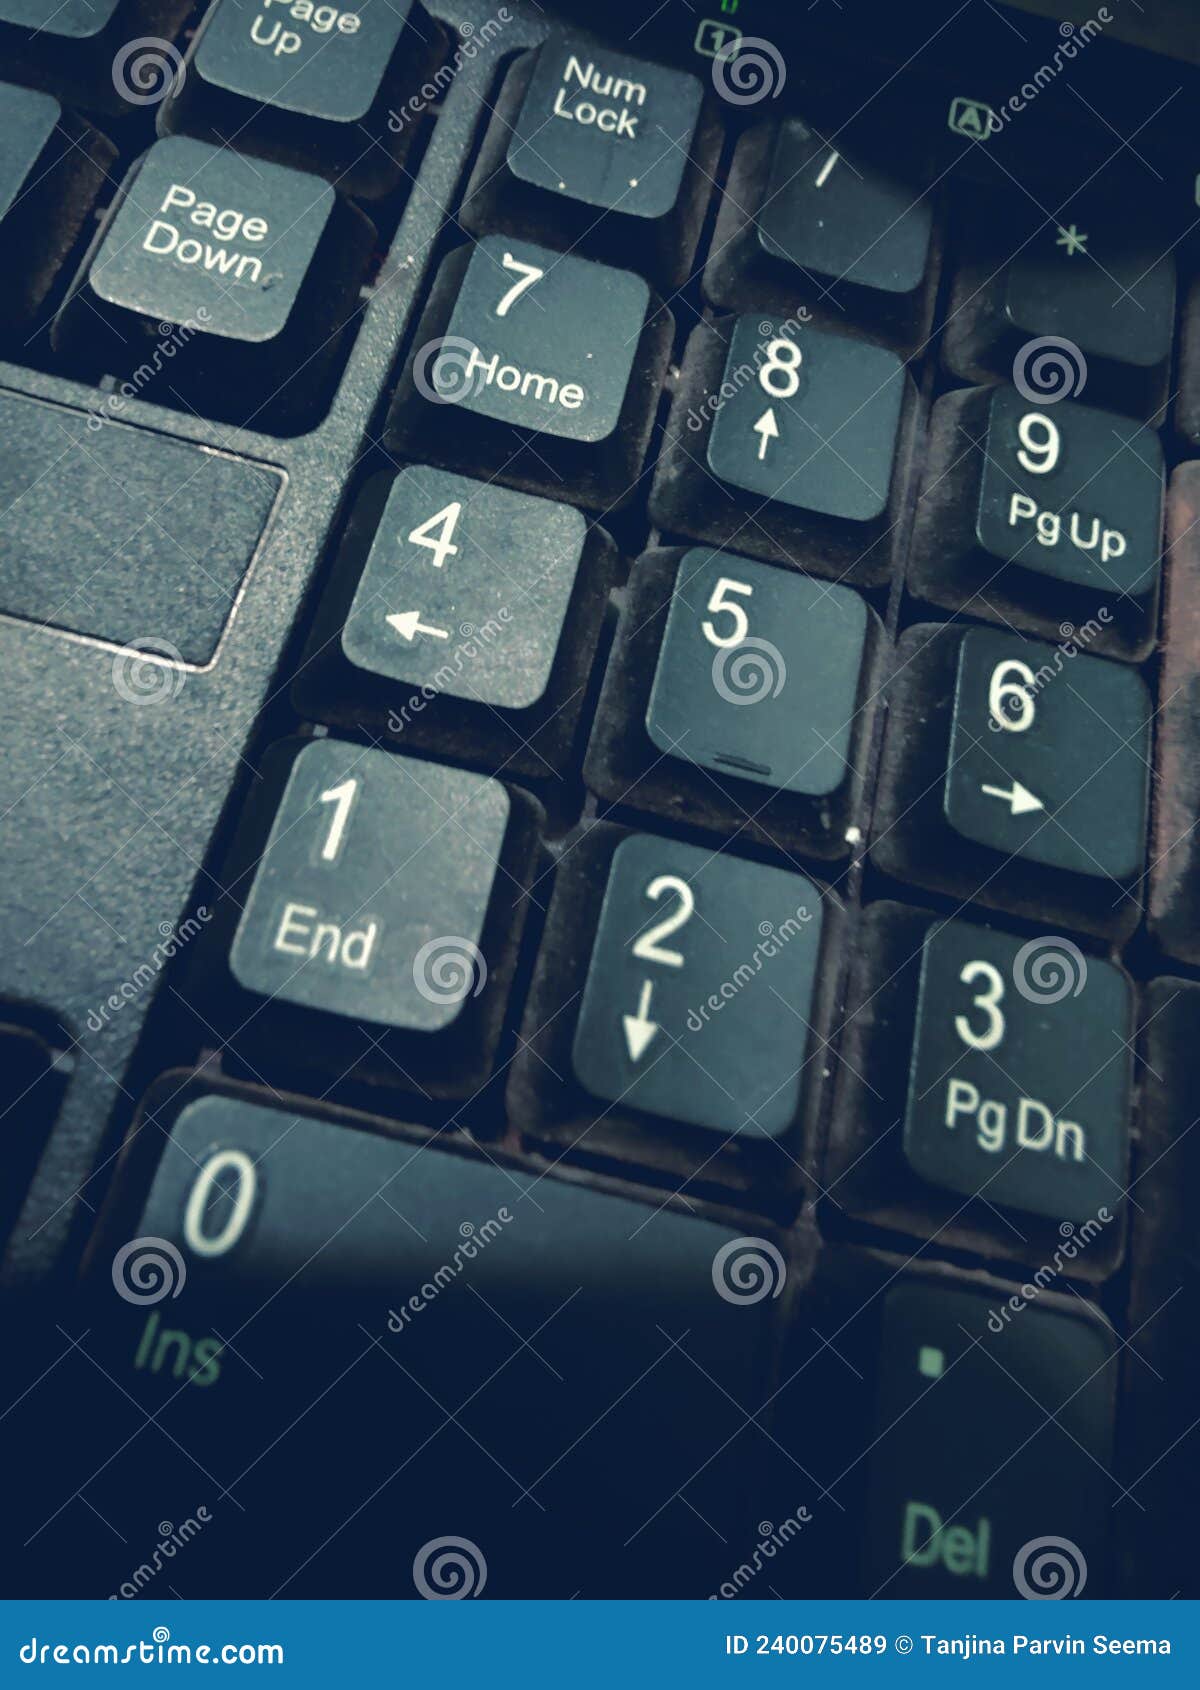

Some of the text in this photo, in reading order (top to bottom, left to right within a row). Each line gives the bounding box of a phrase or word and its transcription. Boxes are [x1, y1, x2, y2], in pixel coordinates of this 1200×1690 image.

[250, 14, 302, 56] Up
[563, 55, 647, 106] Num
[553, 88, 638, 139] Lock
[160, 184, 268, 242] Page
[142, 222, 263, 282] Down
[495, 252, 543, 317] 7
[465, 347, 585, 409] Home
[759, 338, 802, 398] 8
[1017, 412, 1061, 474] 9
[407, 502, 463, 567] 4
[702, 577, 754, 648] 5
[988, 660, 1036, 732] 6
[321, 778, 359, 861] 1
[274, 902, 378, 970] End
[632, 875, 695, 968] 2
[954, 960, 1006, 1052] 3
[183, 1150, 257, 1258] 0
[134, 1310, 226, 1386] Ins
[903, 1500, 991, 1577] Del
